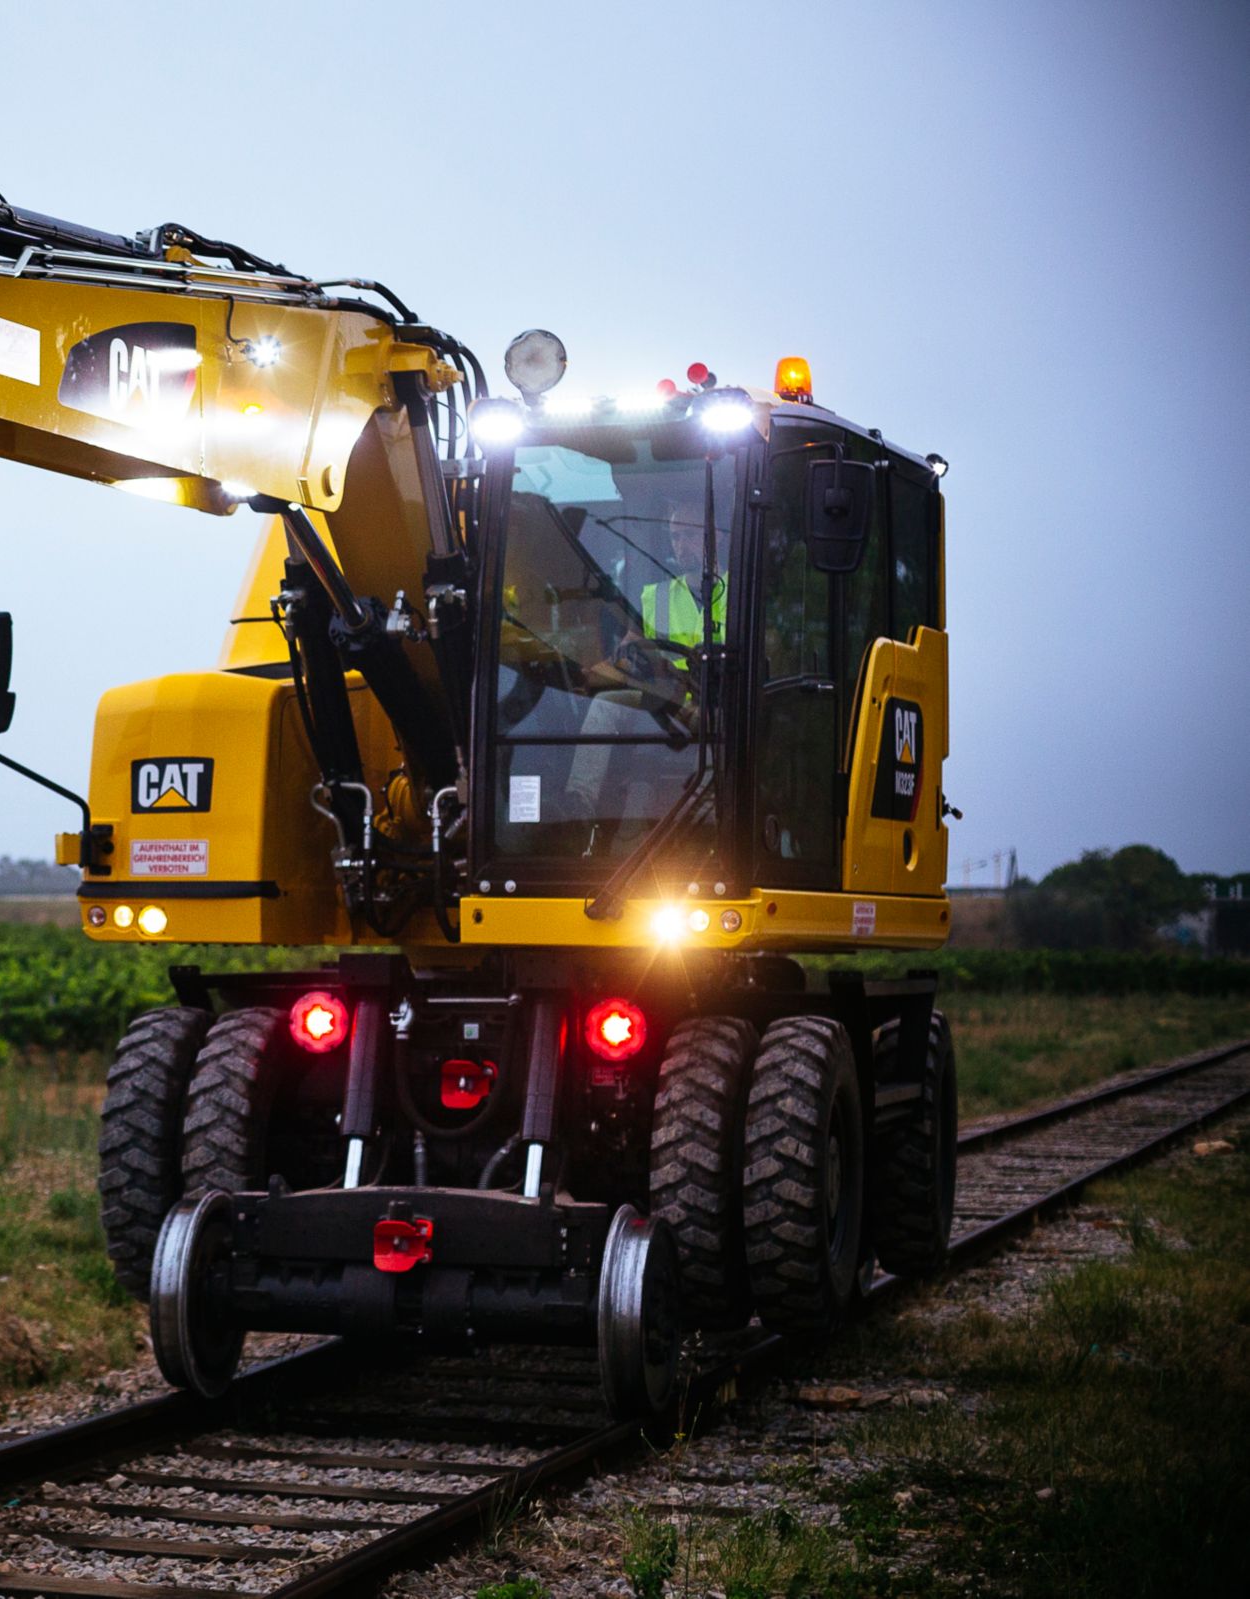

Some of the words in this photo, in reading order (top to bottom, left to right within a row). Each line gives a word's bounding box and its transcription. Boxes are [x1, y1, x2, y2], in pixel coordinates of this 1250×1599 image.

[109, 337, 166, 411] CAT
[895, 707, 917, 764] CAT
[138, 763, 204, 808] CAT
[133, 854, 205, 863] GEFAHRENBEREICH
[139, 844, 187, 852] AUFENTHALT
[189, 844, 200, 852] IM
[148, 864, 189, 873] VERBOTEN
